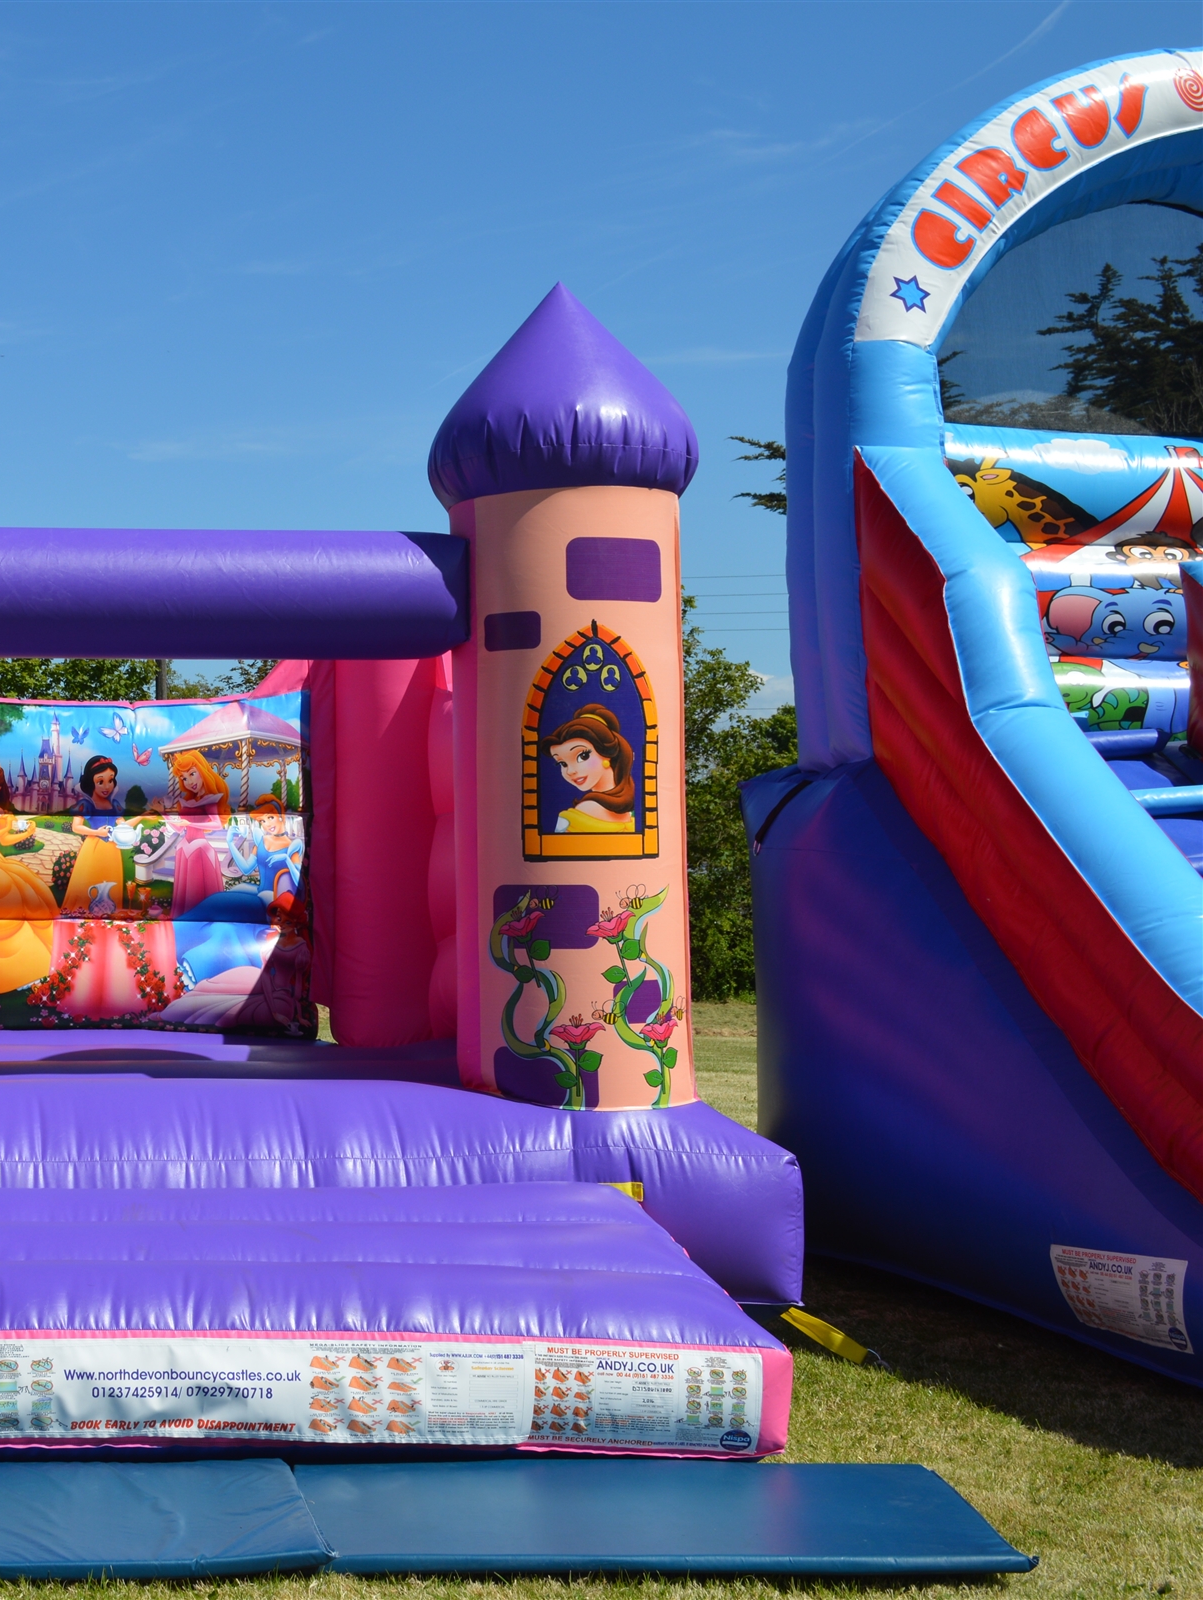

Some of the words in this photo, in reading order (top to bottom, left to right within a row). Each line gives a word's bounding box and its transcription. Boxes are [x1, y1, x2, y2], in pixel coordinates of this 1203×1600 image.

[910, 72, 1149, 271] CIRCUS
[1082, 1252, 1106, 1260] PROPERLY
[1106, 1255, 1137, 1264] SUPERVISED
[1089, 1261, 1133, 1275] ANDYJ.CO.UK
[547, 1347, 570, 1355] MUST
[585, 1349, 627, 1358] PROPERLY
[628, 1351, 679, 1361] SUPERVISED
[596, 1360, 675, 1374] ANDYJ.CO.UK
[63, 1369, 302, 1383] Www.northdevonbouncycastles.co.uk
[186, 1386, 274, 1399] 07929770718
[70, 1420, 103, 1430] BOOK
[104, 1419, 141, 1430] EARLY
[143, 1419, 157, 1429] TO
[159, 1418, 194, 1428] AVOID
[197, 1418, 297, 1433] DISAPPOINTMENT
[564, 1436, 606, 1444] SECURELY
[607, 1438, 654, 1447] ANCHORED
[723, 1434, 751, 1443] Nispa
